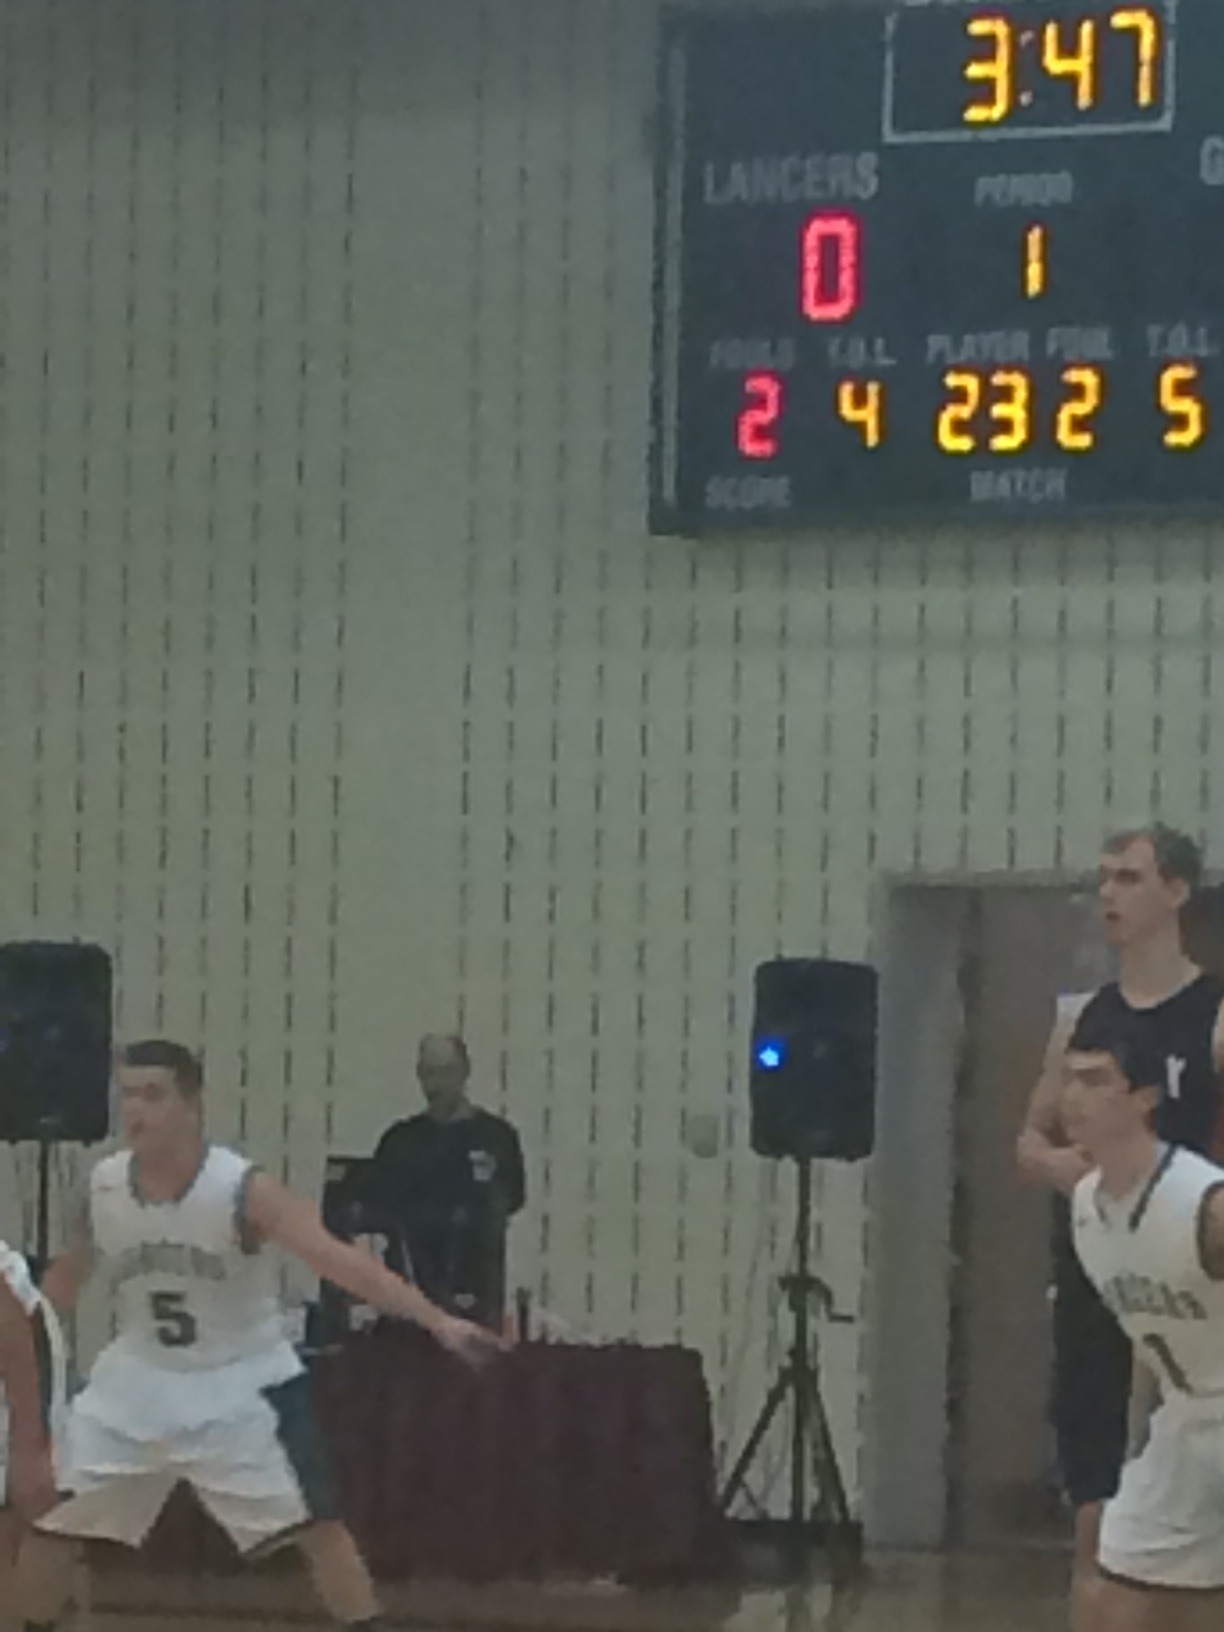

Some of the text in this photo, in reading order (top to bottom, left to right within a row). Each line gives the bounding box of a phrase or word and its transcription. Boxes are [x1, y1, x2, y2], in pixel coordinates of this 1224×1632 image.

[963, 8, 1156, 122] 3:47
[703, 151, 880, 204] LANCERS
[803, 217, 858, 321] 0
[1024, 225, 1043, 299] 1
[737, 376, 781, 458] 2
[838, 380, 879, 448] 4
[938, 370, 1029, 452] 23
[1057, 367, 1099, 448] 2
[1160, 365, 1202, 447] 5
[150, 1291, 198, 1348] 5
